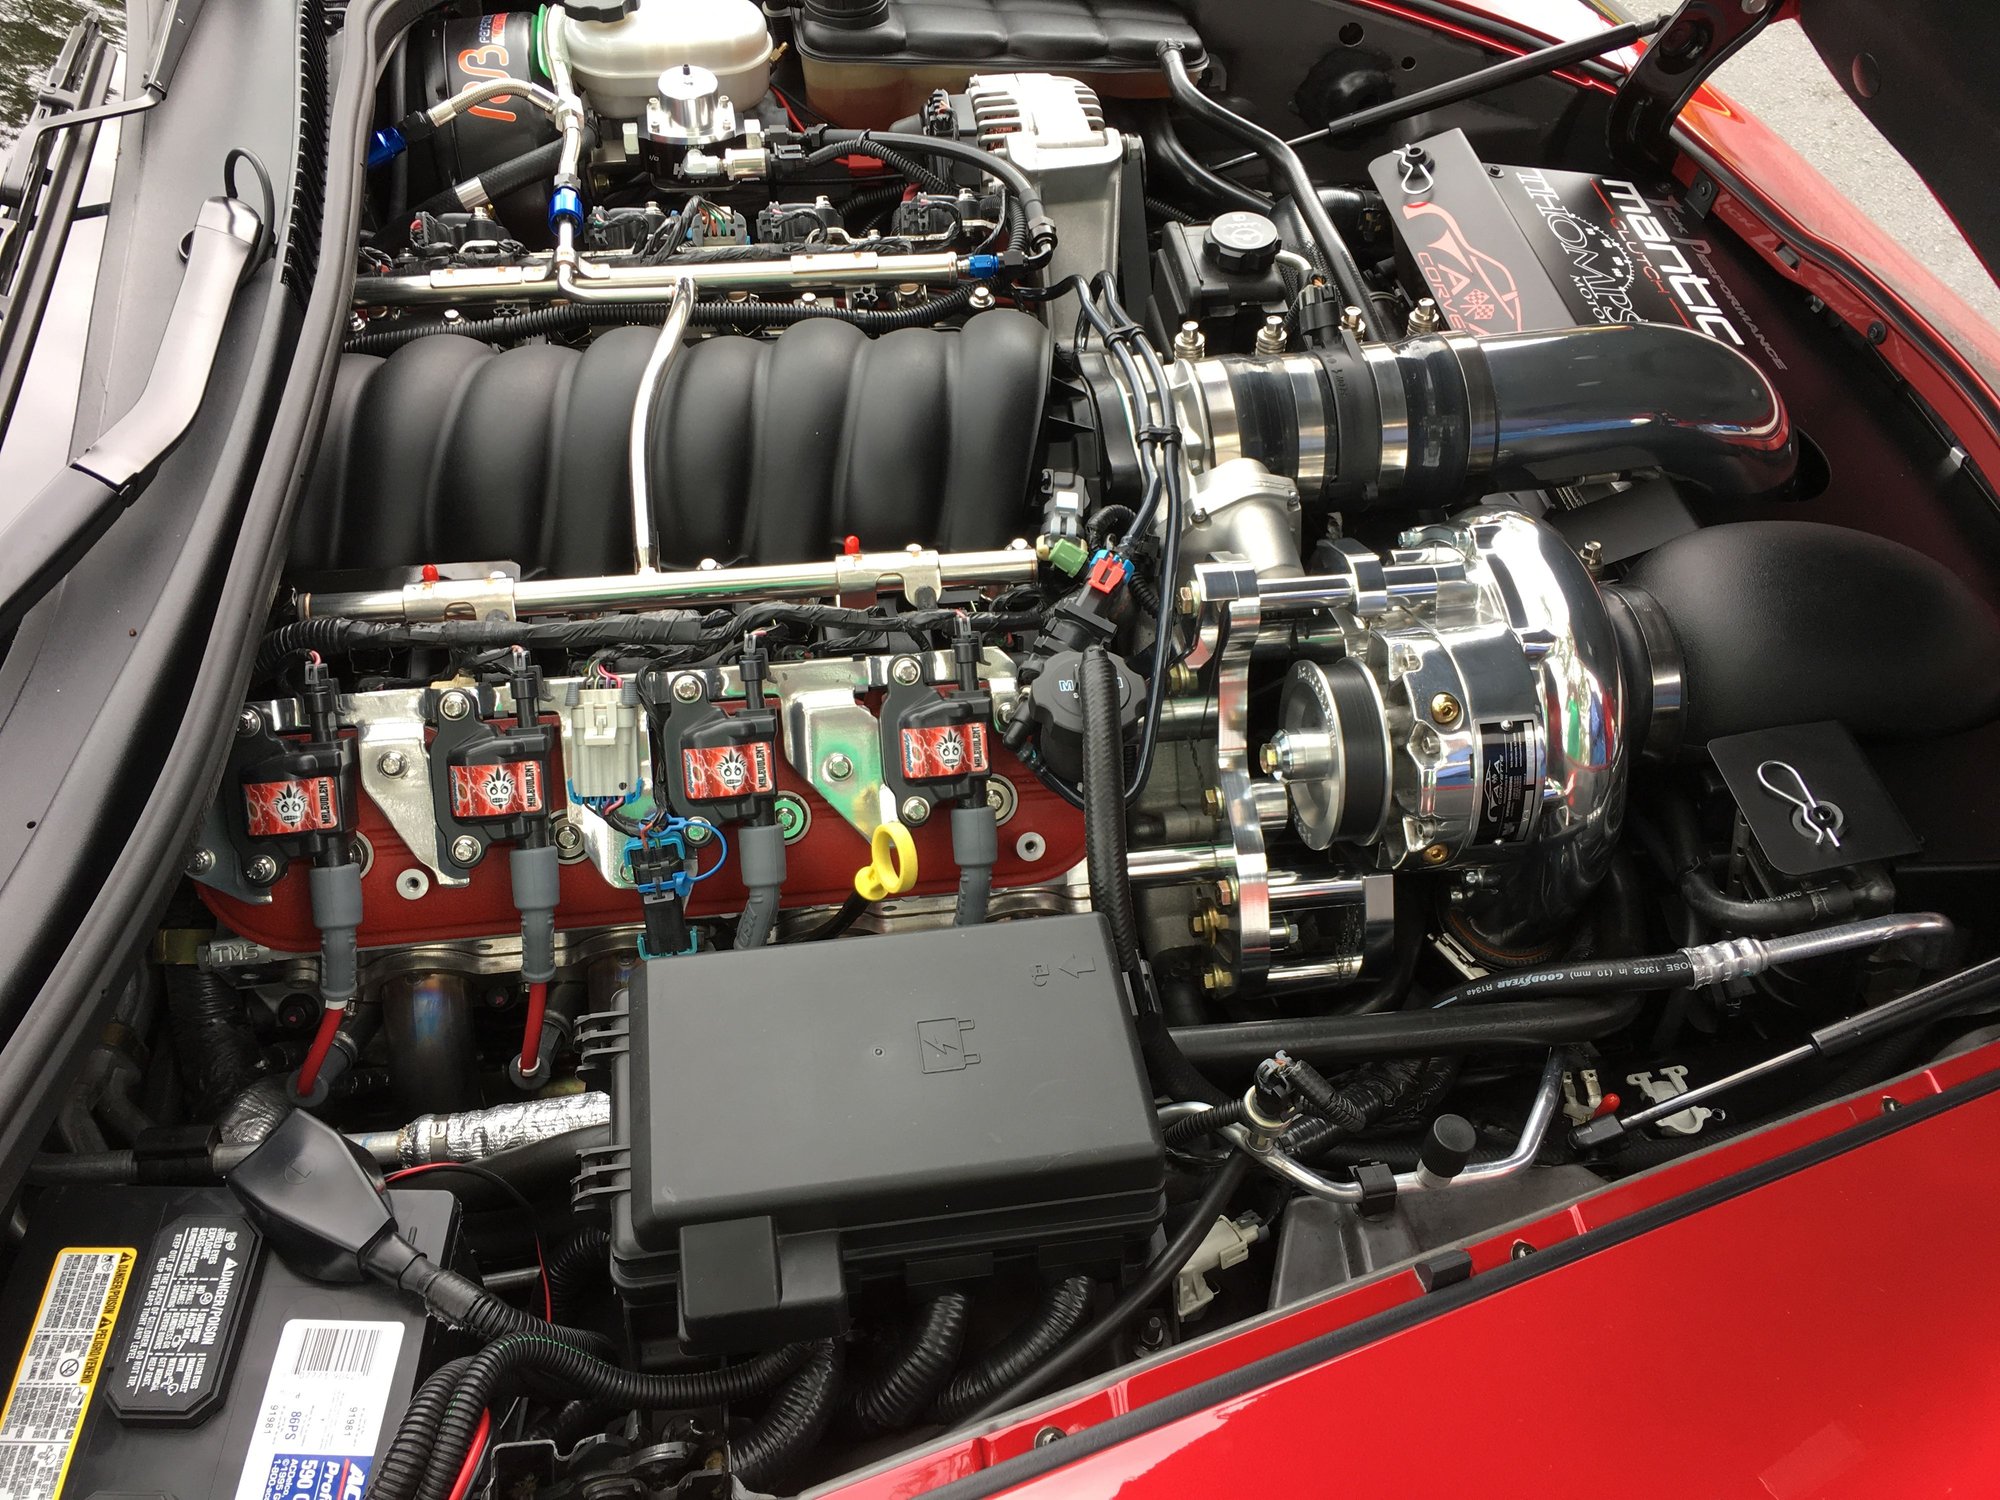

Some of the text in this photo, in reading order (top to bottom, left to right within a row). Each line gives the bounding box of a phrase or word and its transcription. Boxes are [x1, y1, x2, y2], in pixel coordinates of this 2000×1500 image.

[1515, 168, 1648, 323] THOMPS
[1610, 216, 1670, 295] CLUTCH
[1418, 252, 1467, 331] CORVE
[1570, 274, 1609, 323] MOTO
[213, 943, 259, 963] TMS
[1497, 972, 1564, 989] GOODYEAR
[1569, 970, 1592, 980] mm)
[1597, 967, 1613, 978] (10
[1618, 966, 1629, 976] in
[1633, 963, 1660, 975] 13/32
[1466, 983, 1493, 997] R134a
[199, 1227, 217, 1260] EXPLOSIVE
[125, 1256, 167, 1363] KEEP VENT CAPS TIGHT AND LEVEL.
[126, 1233, 183, 1388] KEEP OUT OF THE REACH OF CHILDREN. DO NOT TIP.
[200, 1269, 234, 1345] DANGER/POISON
[79, 1264, 128, 1383] DANGER/POISON PELIGRO/VENENO
[262, 1404, 279, 1434] 91981
[283, 1411, 303, 1439] 86PS
[342, 1406, 358, 1436] 91981
[294, 1459, 319, 1488] 590
